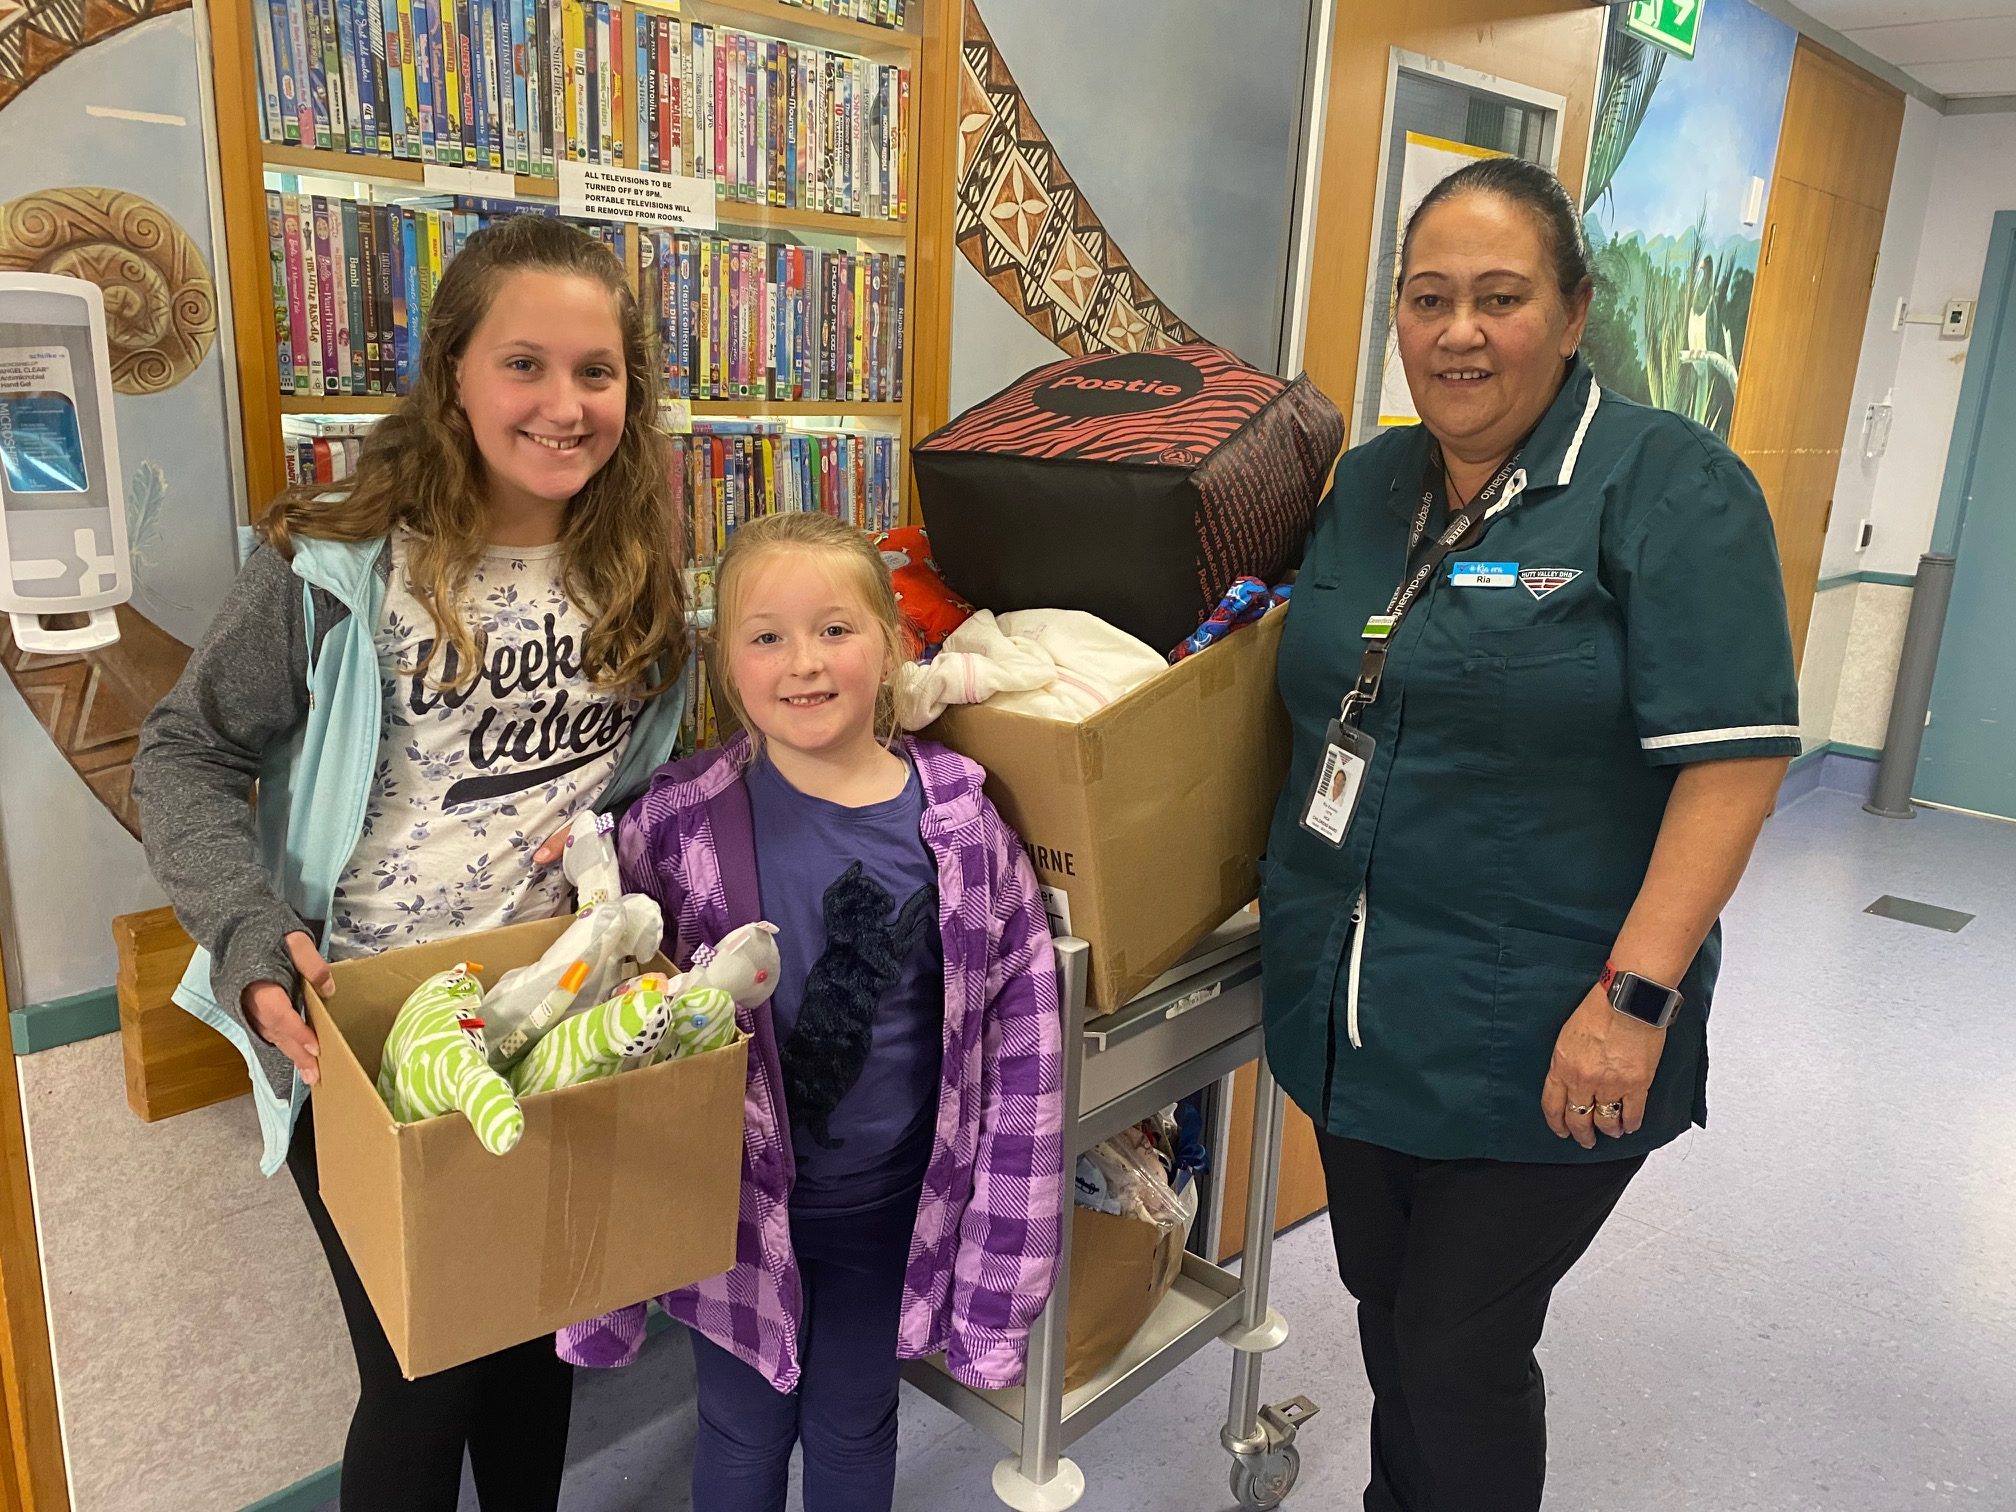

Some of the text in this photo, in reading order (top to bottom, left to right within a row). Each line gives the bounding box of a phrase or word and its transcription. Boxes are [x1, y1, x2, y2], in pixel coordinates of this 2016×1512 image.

[355, 19, 368, 38] Just
[359, 40, 369, 55] add
[460, 34, 471, 76] ALIENS
[501, 22, 511, 67] BEDTIME
[553, 46, 562, 74] Suite
[554, 75, 562, 96] Life
[649, 69, 657, 121] RATATOUILLE
[671, 77, 680, 147] DESPICABLE ME
[835, 103, 843, 116] 10
[584, 171, 599, 180] ALL
[601, 173, 649, 186] TELEVISIONS
[663, 181, 672, 189] BE
[585, 183, 616, 192] TURNED
[646, 190, 662, 198] 8PM.
[585, 194, 691, 213] PORTABLE TELEVISIONS WILL
[597, 207, 634, 217] REMOVED
[635, 211, 656, 219] FROM
[657, 214, 685, 222] ROOMS.
[349, 257, 359, 288] Bambi
[305, 257, 319, 343] THE LITTLE RASCALS
[324, 292, 332, 316] Pearl
[409, 302, 418, 315] Go
[831, 305, 836, 315] OF
[669, 309, 677, 337] Diego
[325, 318, 334, 357] Princess
[1048, 375, 1183, 397] Postie
[726, 480, 734, 497] GUY
[726, 501, 734, 525] THING
[1199, 483, 1223, 550] Postie.co.nz
[1198, 526, 1222, 590] Postie.co.nz
